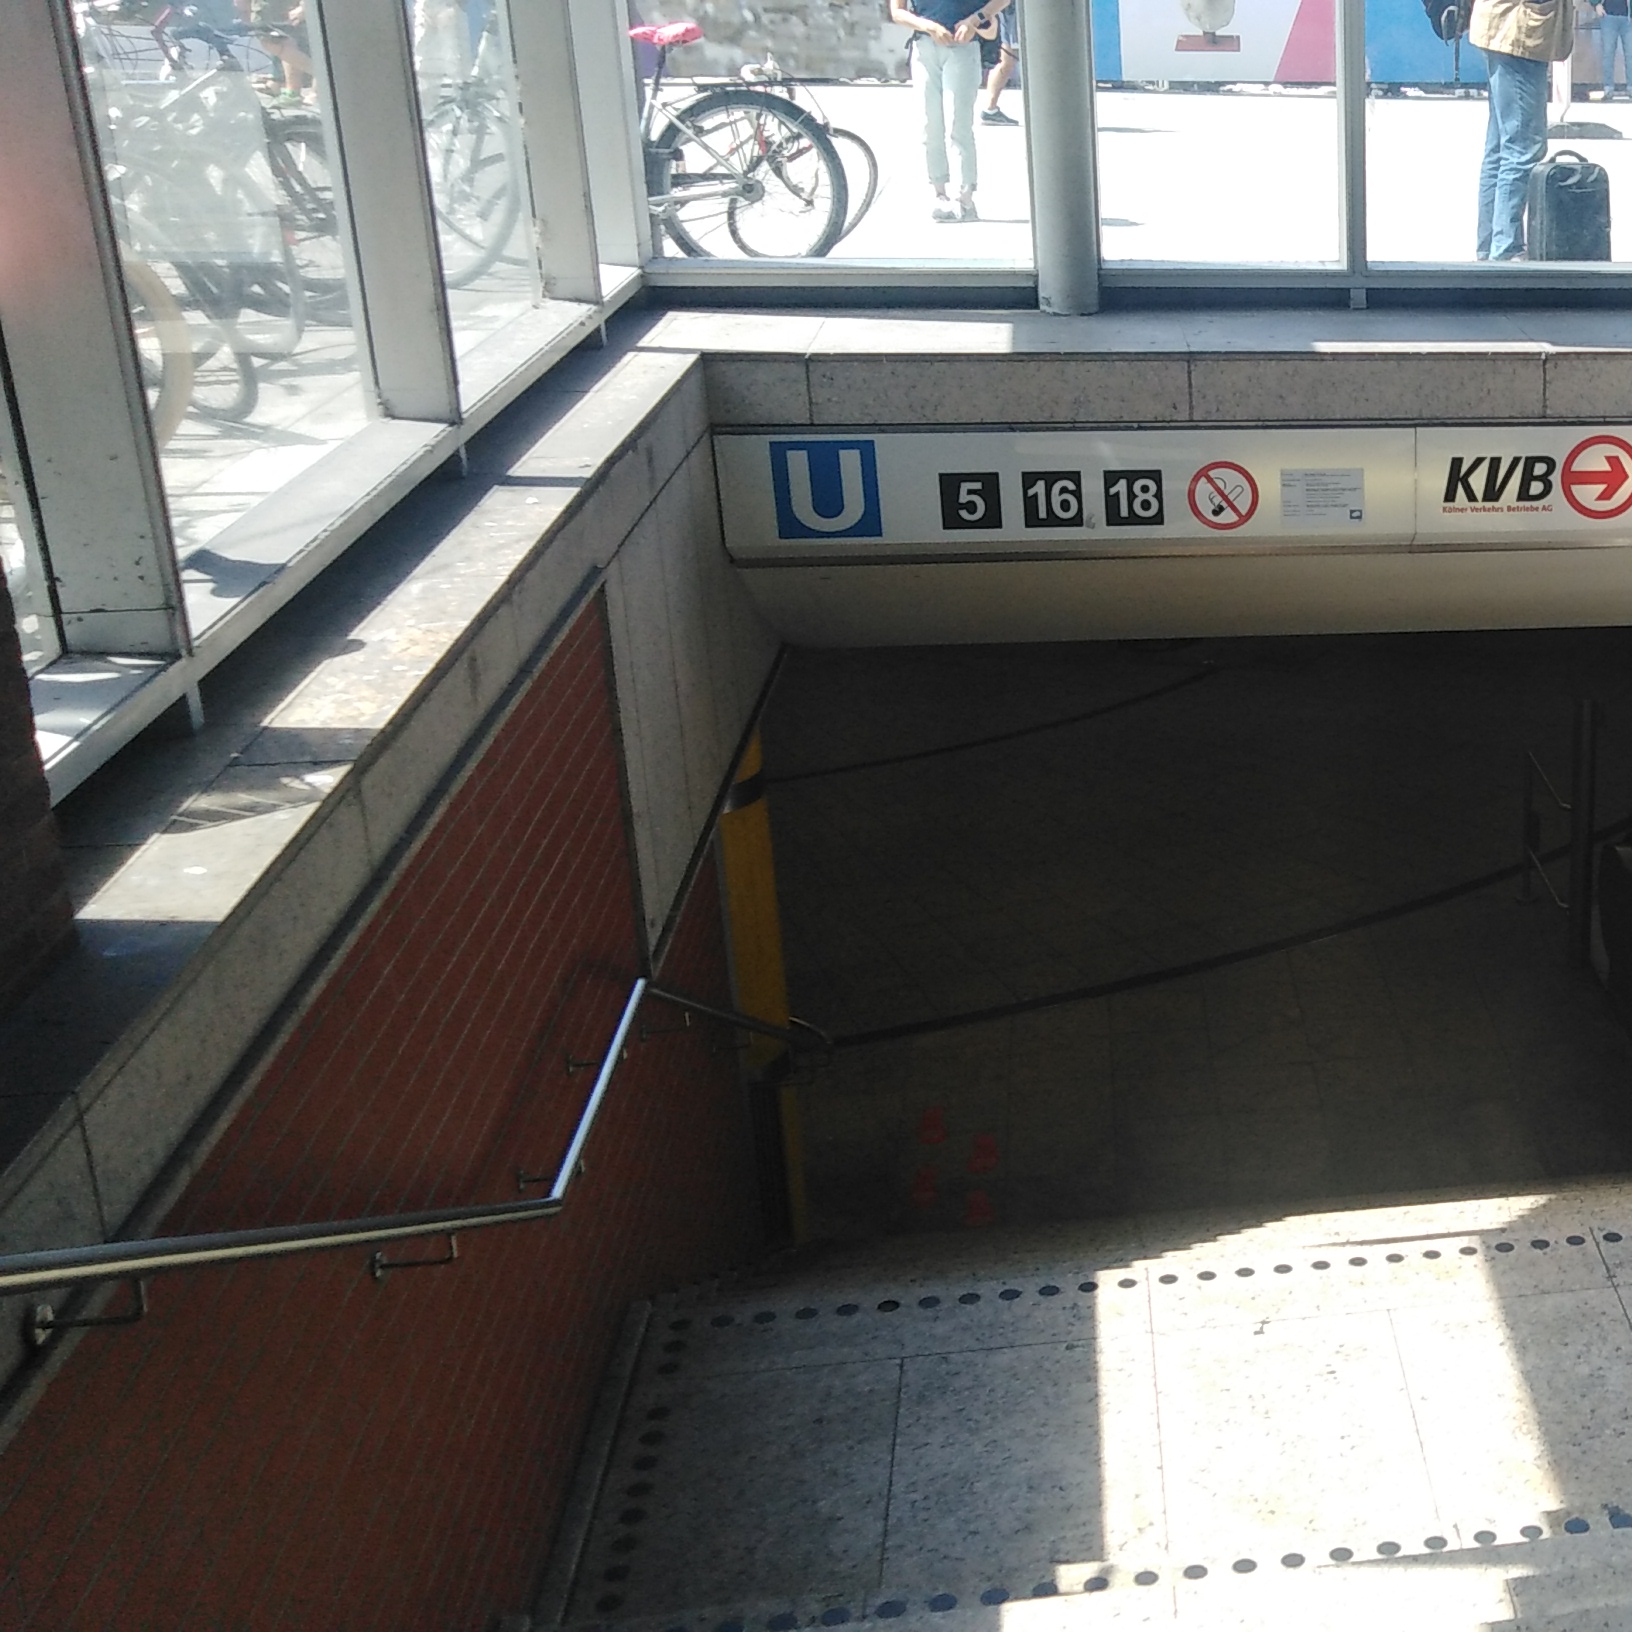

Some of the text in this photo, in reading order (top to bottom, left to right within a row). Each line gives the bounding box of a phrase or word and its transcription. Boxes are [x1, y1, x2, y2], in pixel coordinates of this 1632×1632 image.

[785, 448, 865, 533] U
[957, 477, 1160, 522] 5 16 18
[1442, 455, 1557, 503] KVB
[1506, 504, 1539, 513] Betriebe
